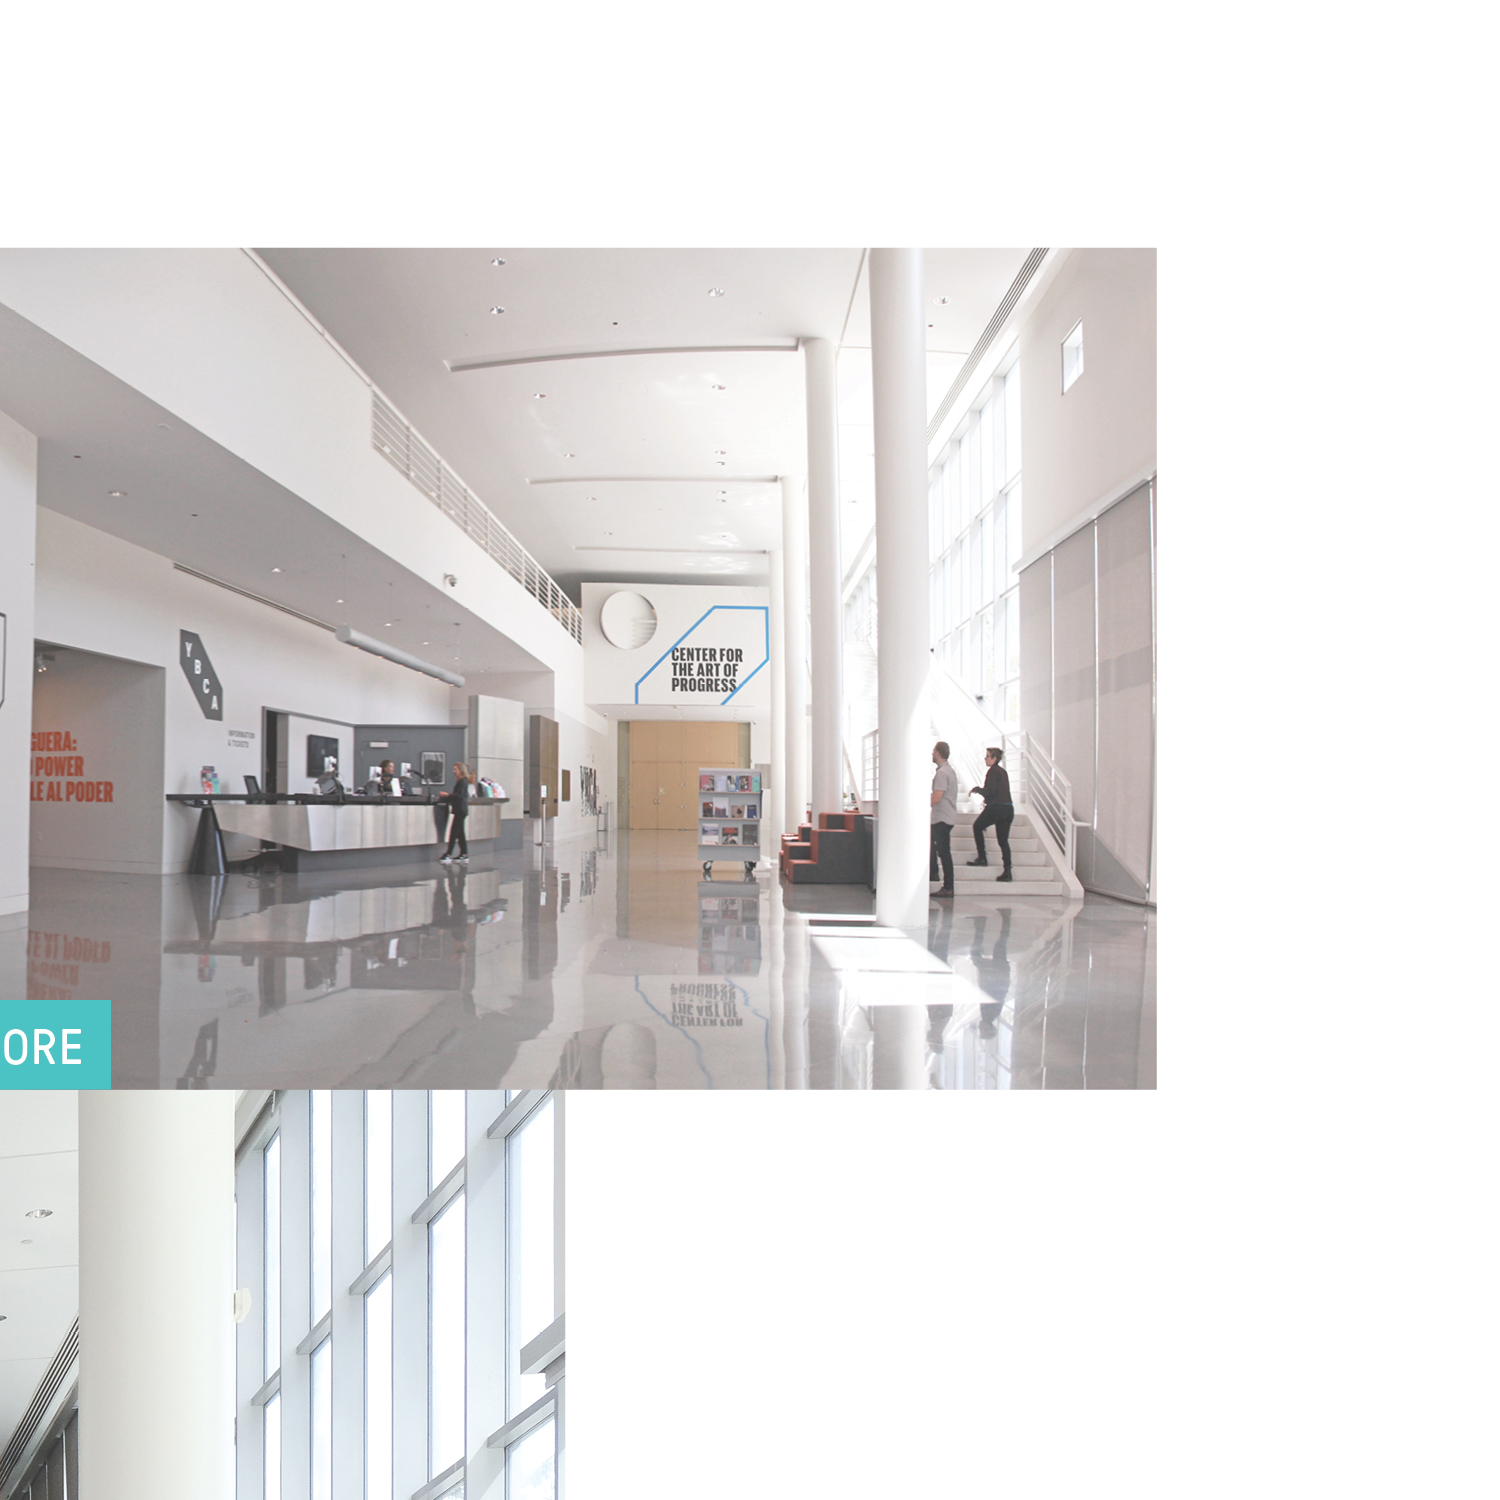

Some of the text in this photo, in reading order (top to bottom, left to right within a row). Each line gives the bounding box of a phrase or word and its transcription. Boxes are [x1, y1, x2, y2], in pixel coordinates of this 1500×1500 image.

[671, 647, 743, 662] CENTER FOR
[671, 662, 739, 677] THE ART OF
[671, 677, 737, 693] PROGRESS
[35, 756, 84, 777] POWER
[46, 781, 63, 801] AL
[66, 781, 114, 802] PODER
